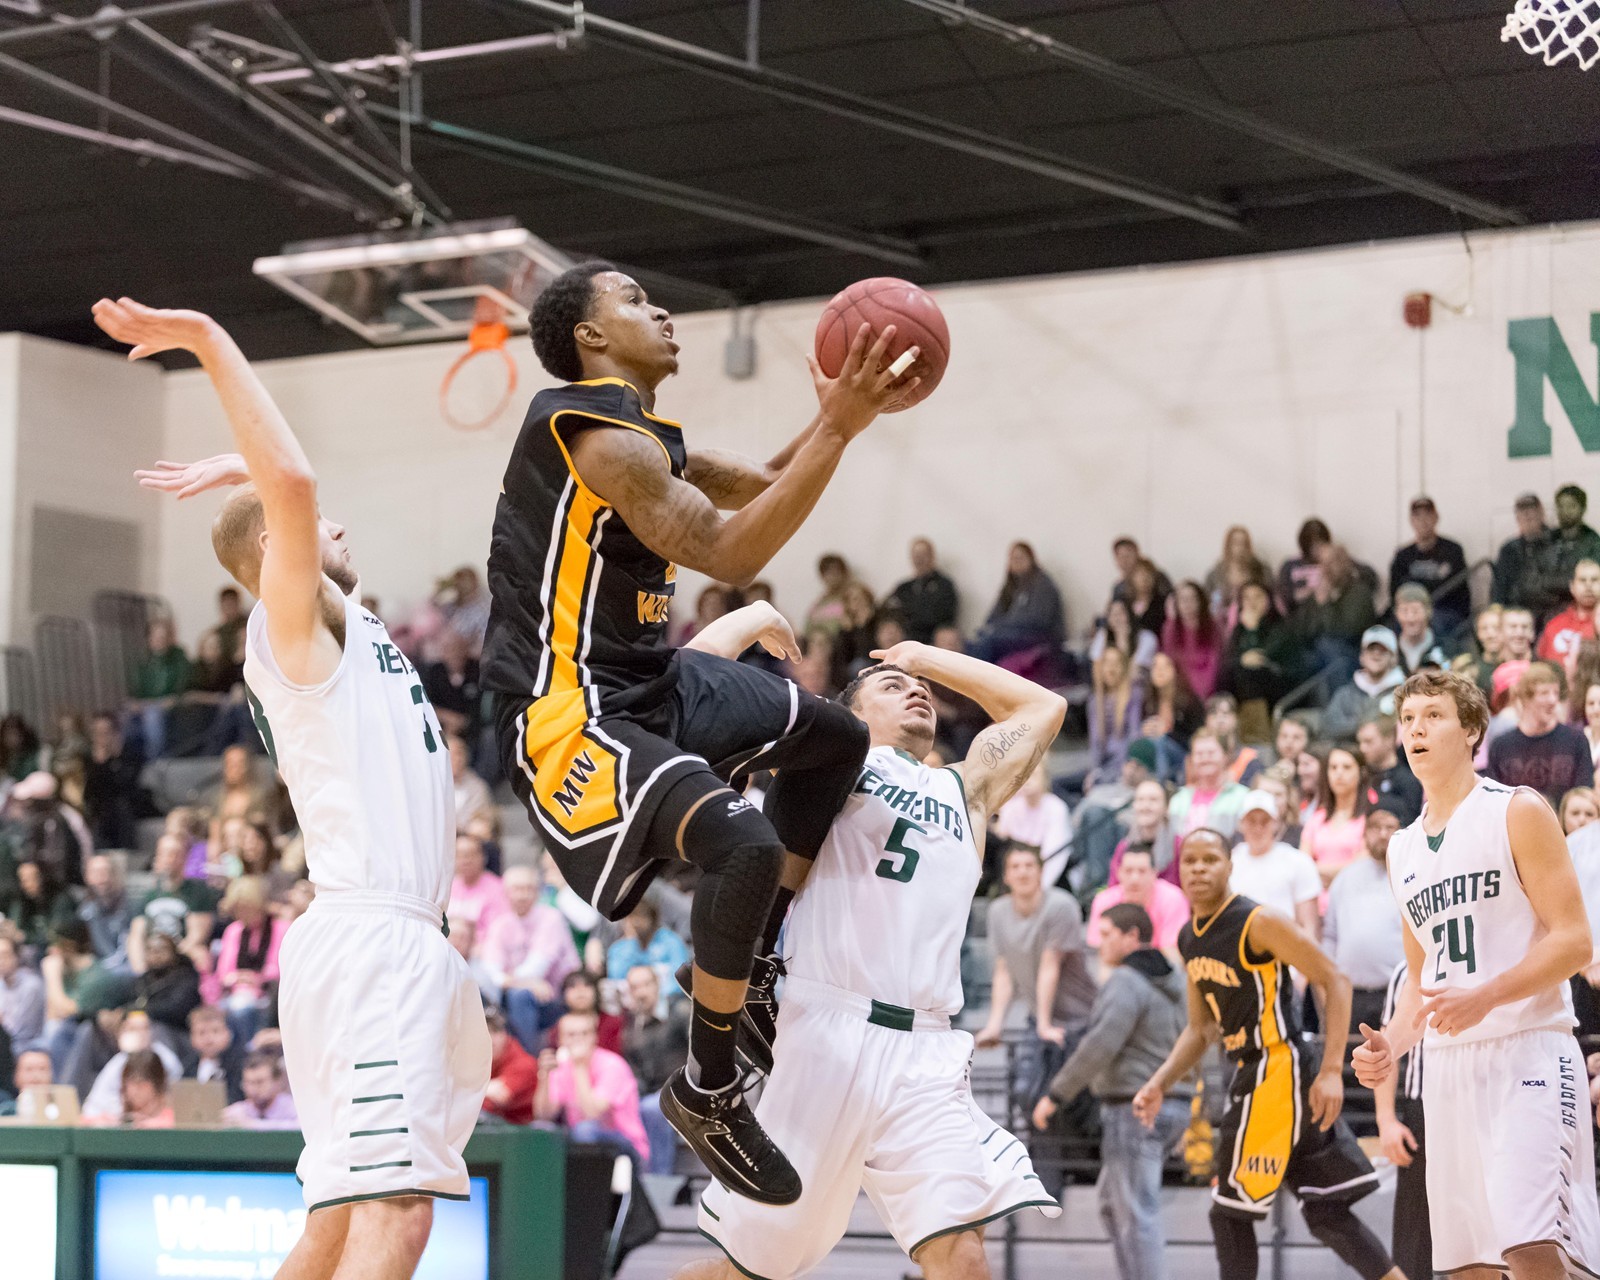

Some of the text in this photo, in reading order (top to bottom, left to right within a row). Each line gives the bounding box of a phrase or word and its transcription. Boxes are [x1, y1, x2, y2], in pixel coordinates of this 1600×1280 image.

[980, 723, 1031, 770] Believe
[551, 750, 597, 817] MW
[854, 765, 963, 842] EARCATS
[875, 817, 927, 883] 5
[1406, 870, 1501, 928] BEARCATS
[1432, 914, 1476, 983] 24
[1243, 1154, 1283, 1176] MW
